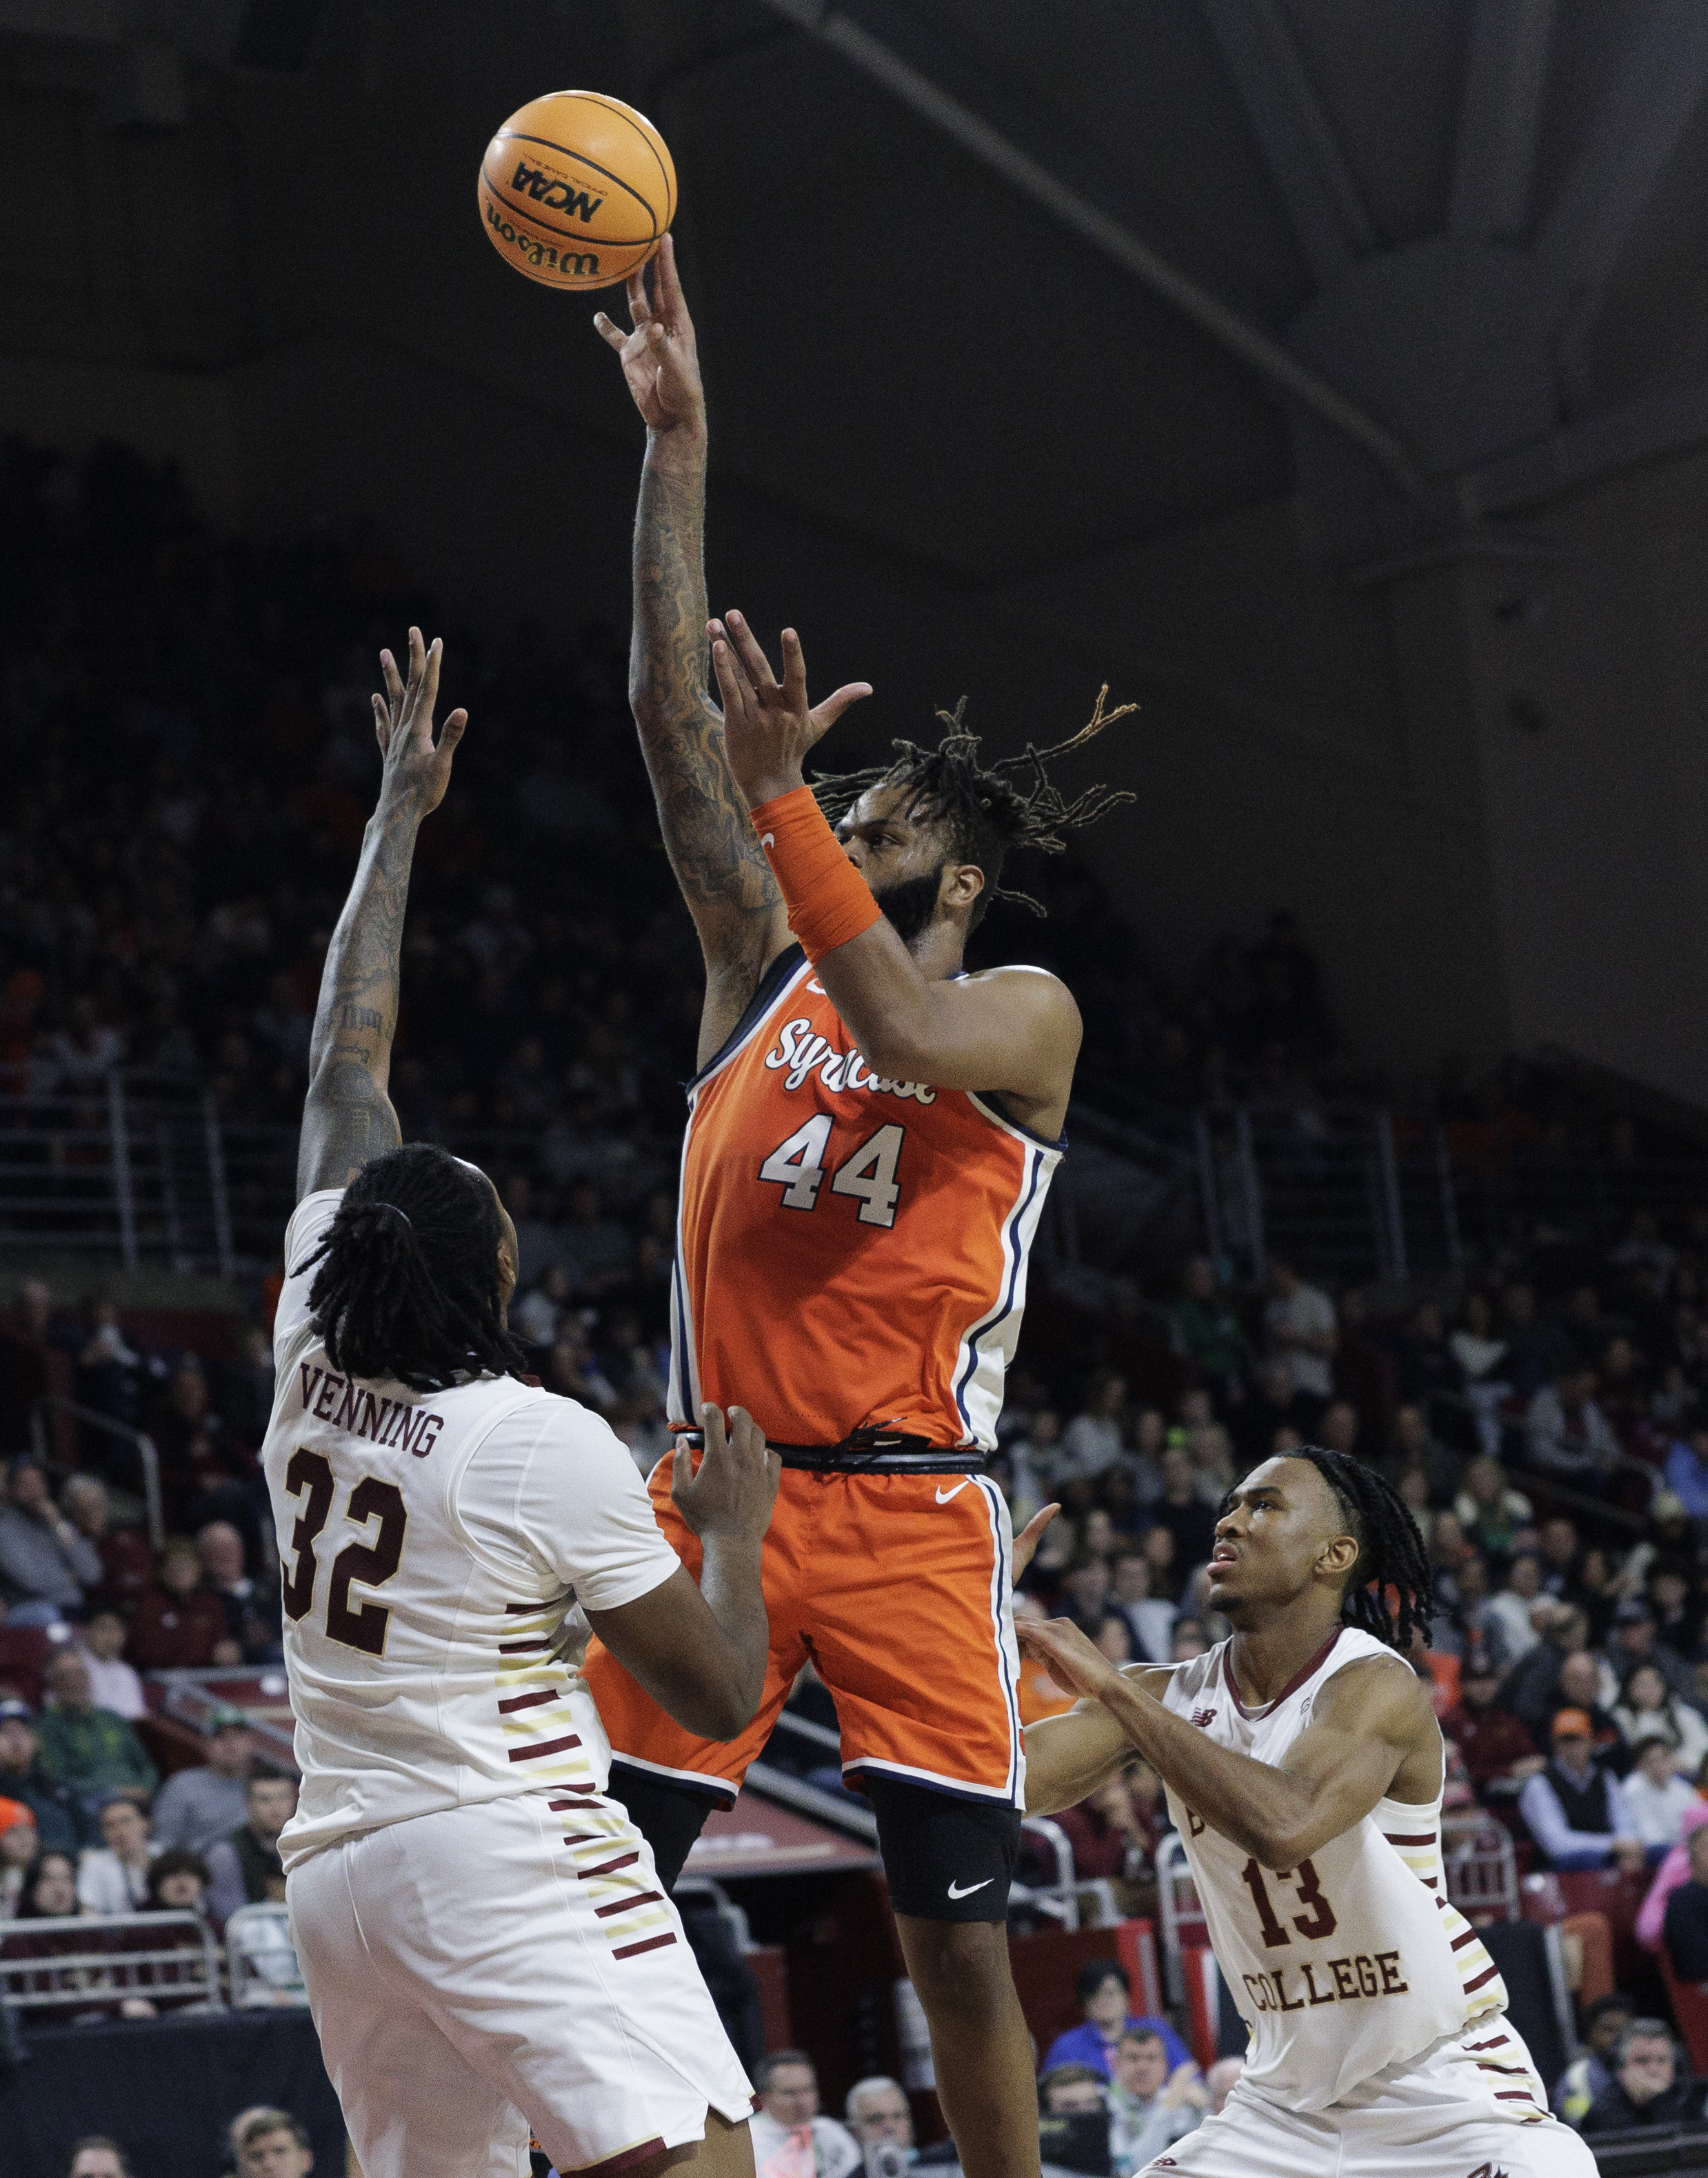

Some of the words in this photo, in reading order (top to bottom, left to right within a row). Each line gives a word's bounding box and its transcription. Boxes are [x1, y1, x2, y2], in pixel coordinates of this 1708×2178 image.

[485, 199, 600, 276] Wilson
[511, 161, 603, 223] NCAA
[758, 1111, 907, 1230] 44
[300, 1362, 445, 1459] VENNING
[281, 1446, 410, 1660] 32
[1241, 1857, 1338, 1948] 13
[1241, 1950, 1409, 2013] COLLEGE
